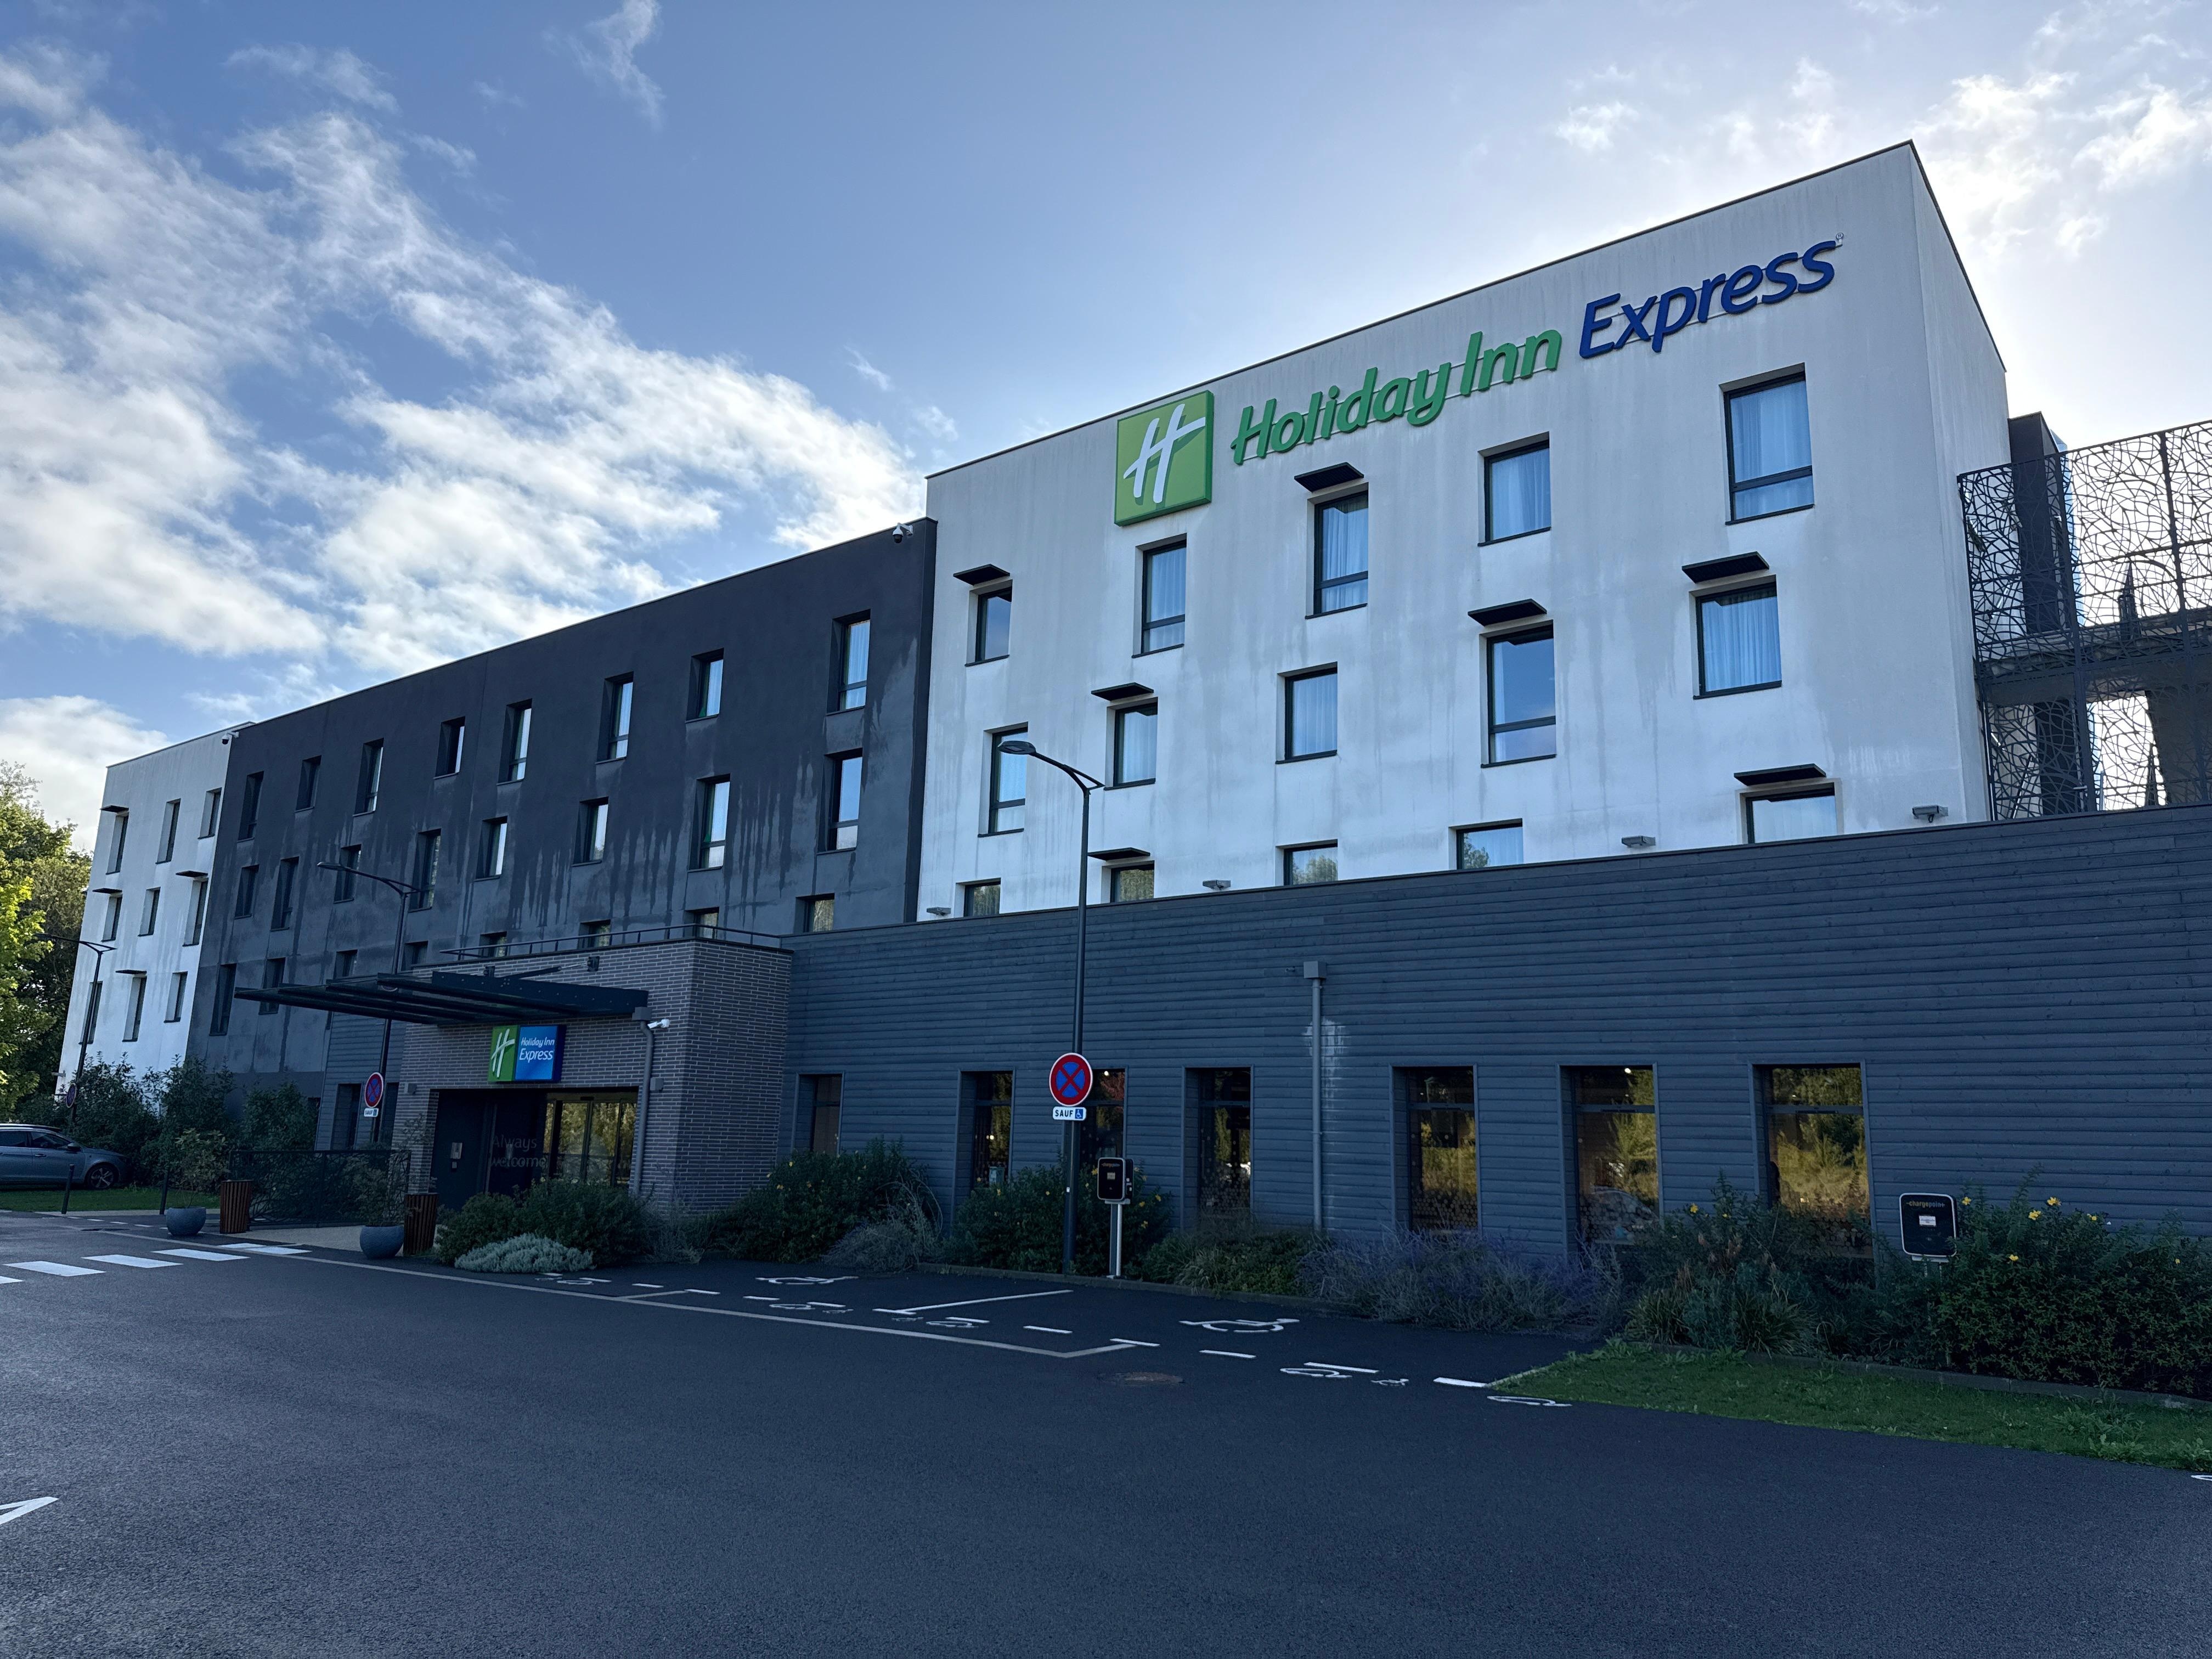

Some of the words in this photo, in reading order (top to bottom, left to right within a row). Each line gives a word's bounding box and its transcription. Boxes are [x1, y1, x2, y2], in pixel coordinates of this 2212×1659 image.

[1232, 364, 1451, 464] Holiday
[1461, 331, 1562, 396] Inn
[1578, 240, 1836, 359] Express
[521, 1036, 544, 1048] Holiday
[544, 1036, 555, 1046] Inn
[519, 1048, 554, 1063] Express
[1055, 1109, 1074, 1118] SAUF
[493, 1134, 537, 1152] Always
[492, 1154, 546, 1167] welcome
